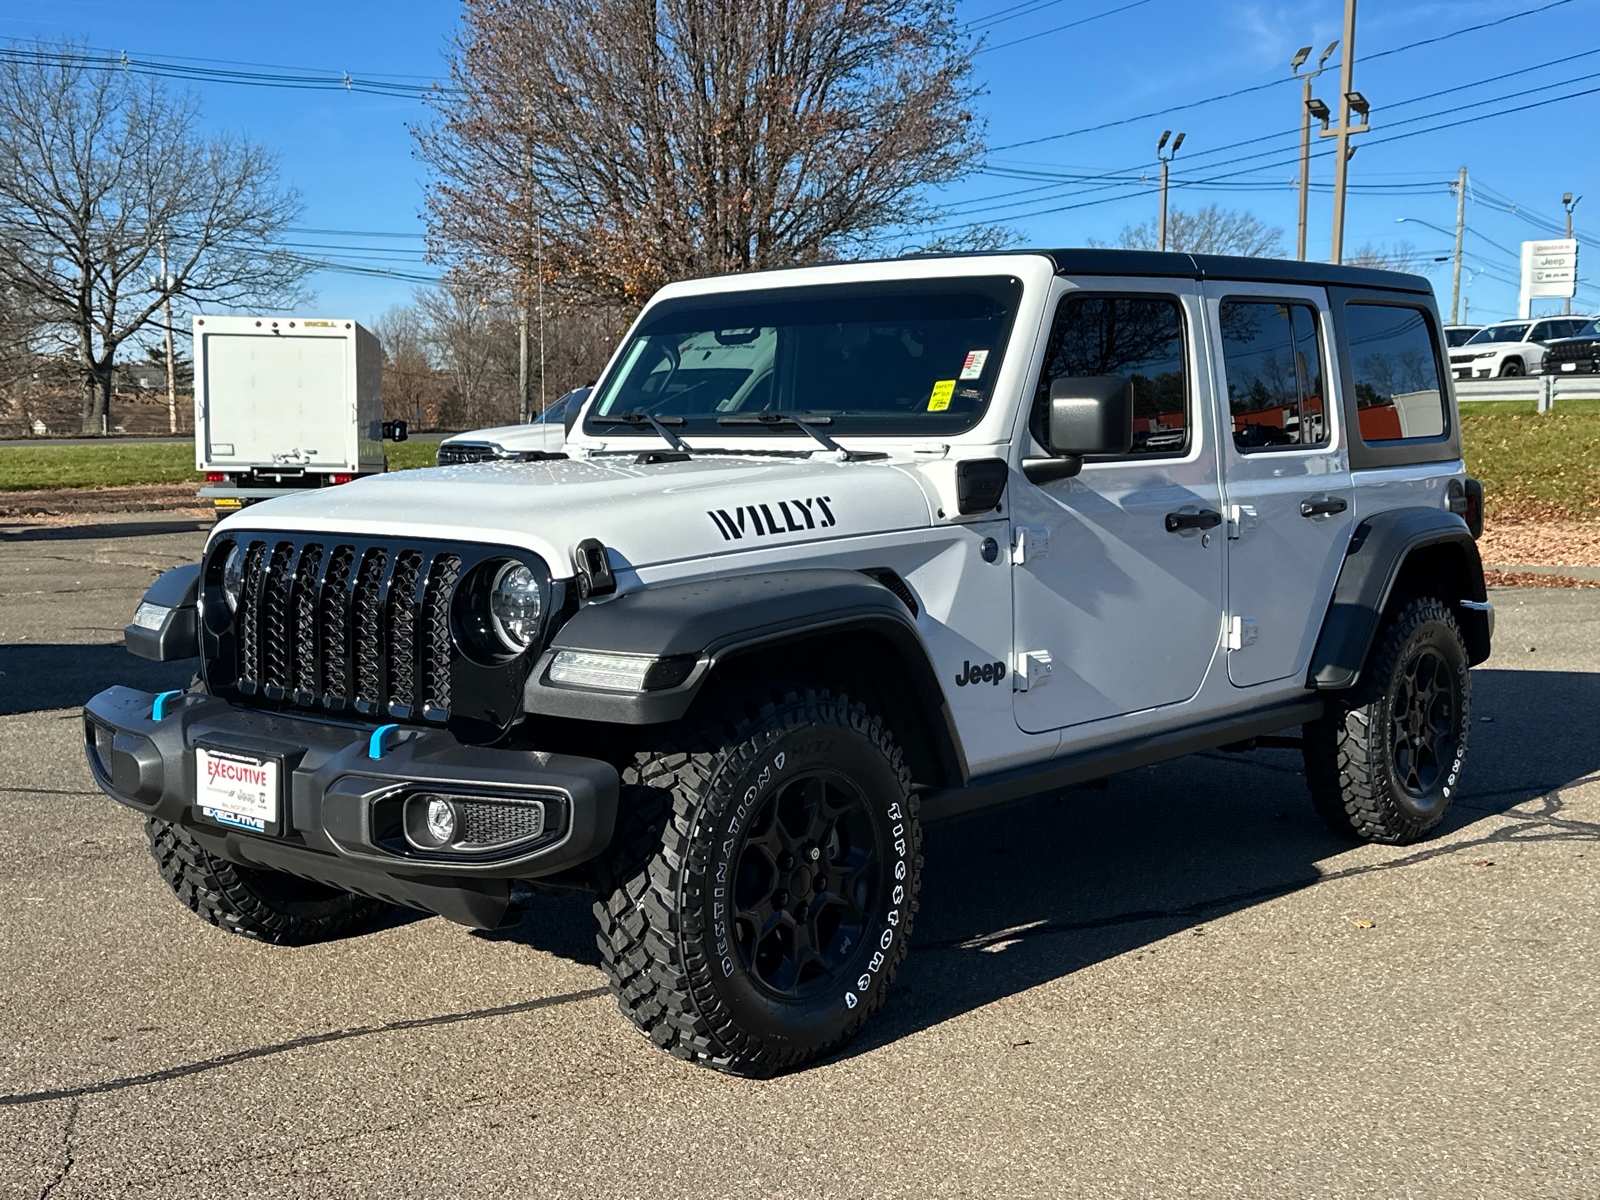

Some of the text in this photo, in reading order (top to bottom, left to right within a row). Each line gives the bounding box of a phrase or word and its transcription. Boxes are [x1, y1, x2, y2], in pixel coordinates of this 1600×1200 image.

[1541, 257, 1566, 266] Jeep
[706, 496, 836, 541] WILLYS
[955, 660, 1006, 687] Jeep
[207, 759, 267, 787] EXECUTIVE
[203, 806, 265, 829] EXECUTIVE
[714, 766, 770, 978] DESTINATION
